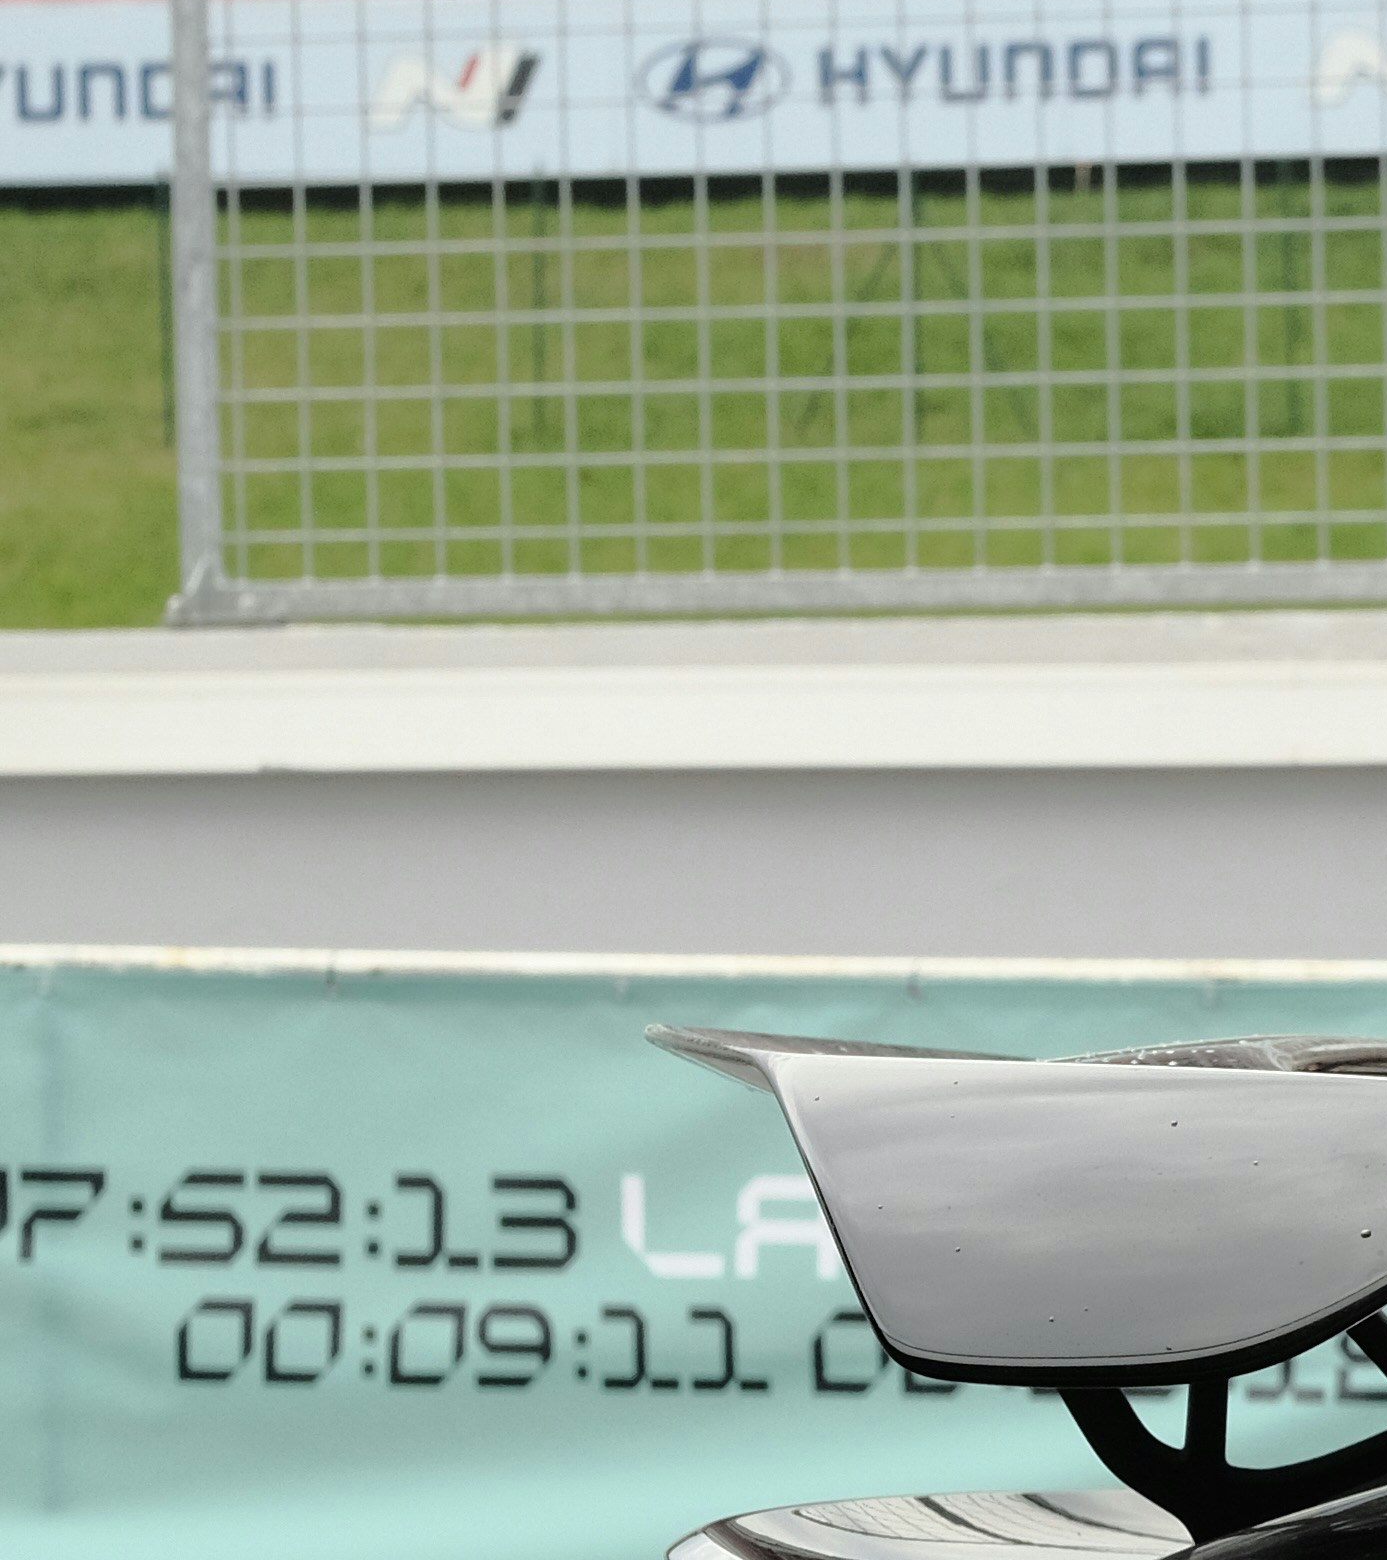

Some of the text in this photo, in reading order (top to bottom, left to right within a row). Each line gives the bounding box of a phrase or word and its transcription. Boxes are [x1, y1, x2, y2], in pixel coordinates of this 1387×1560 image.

[0, 57, 279, 124] UNDAI
[816, 32, 1214, 110] HYUNDAI
[0, 1168, 581, 1269] 7:52:13
[175, 1300, 774, 1393] 00:09:11
